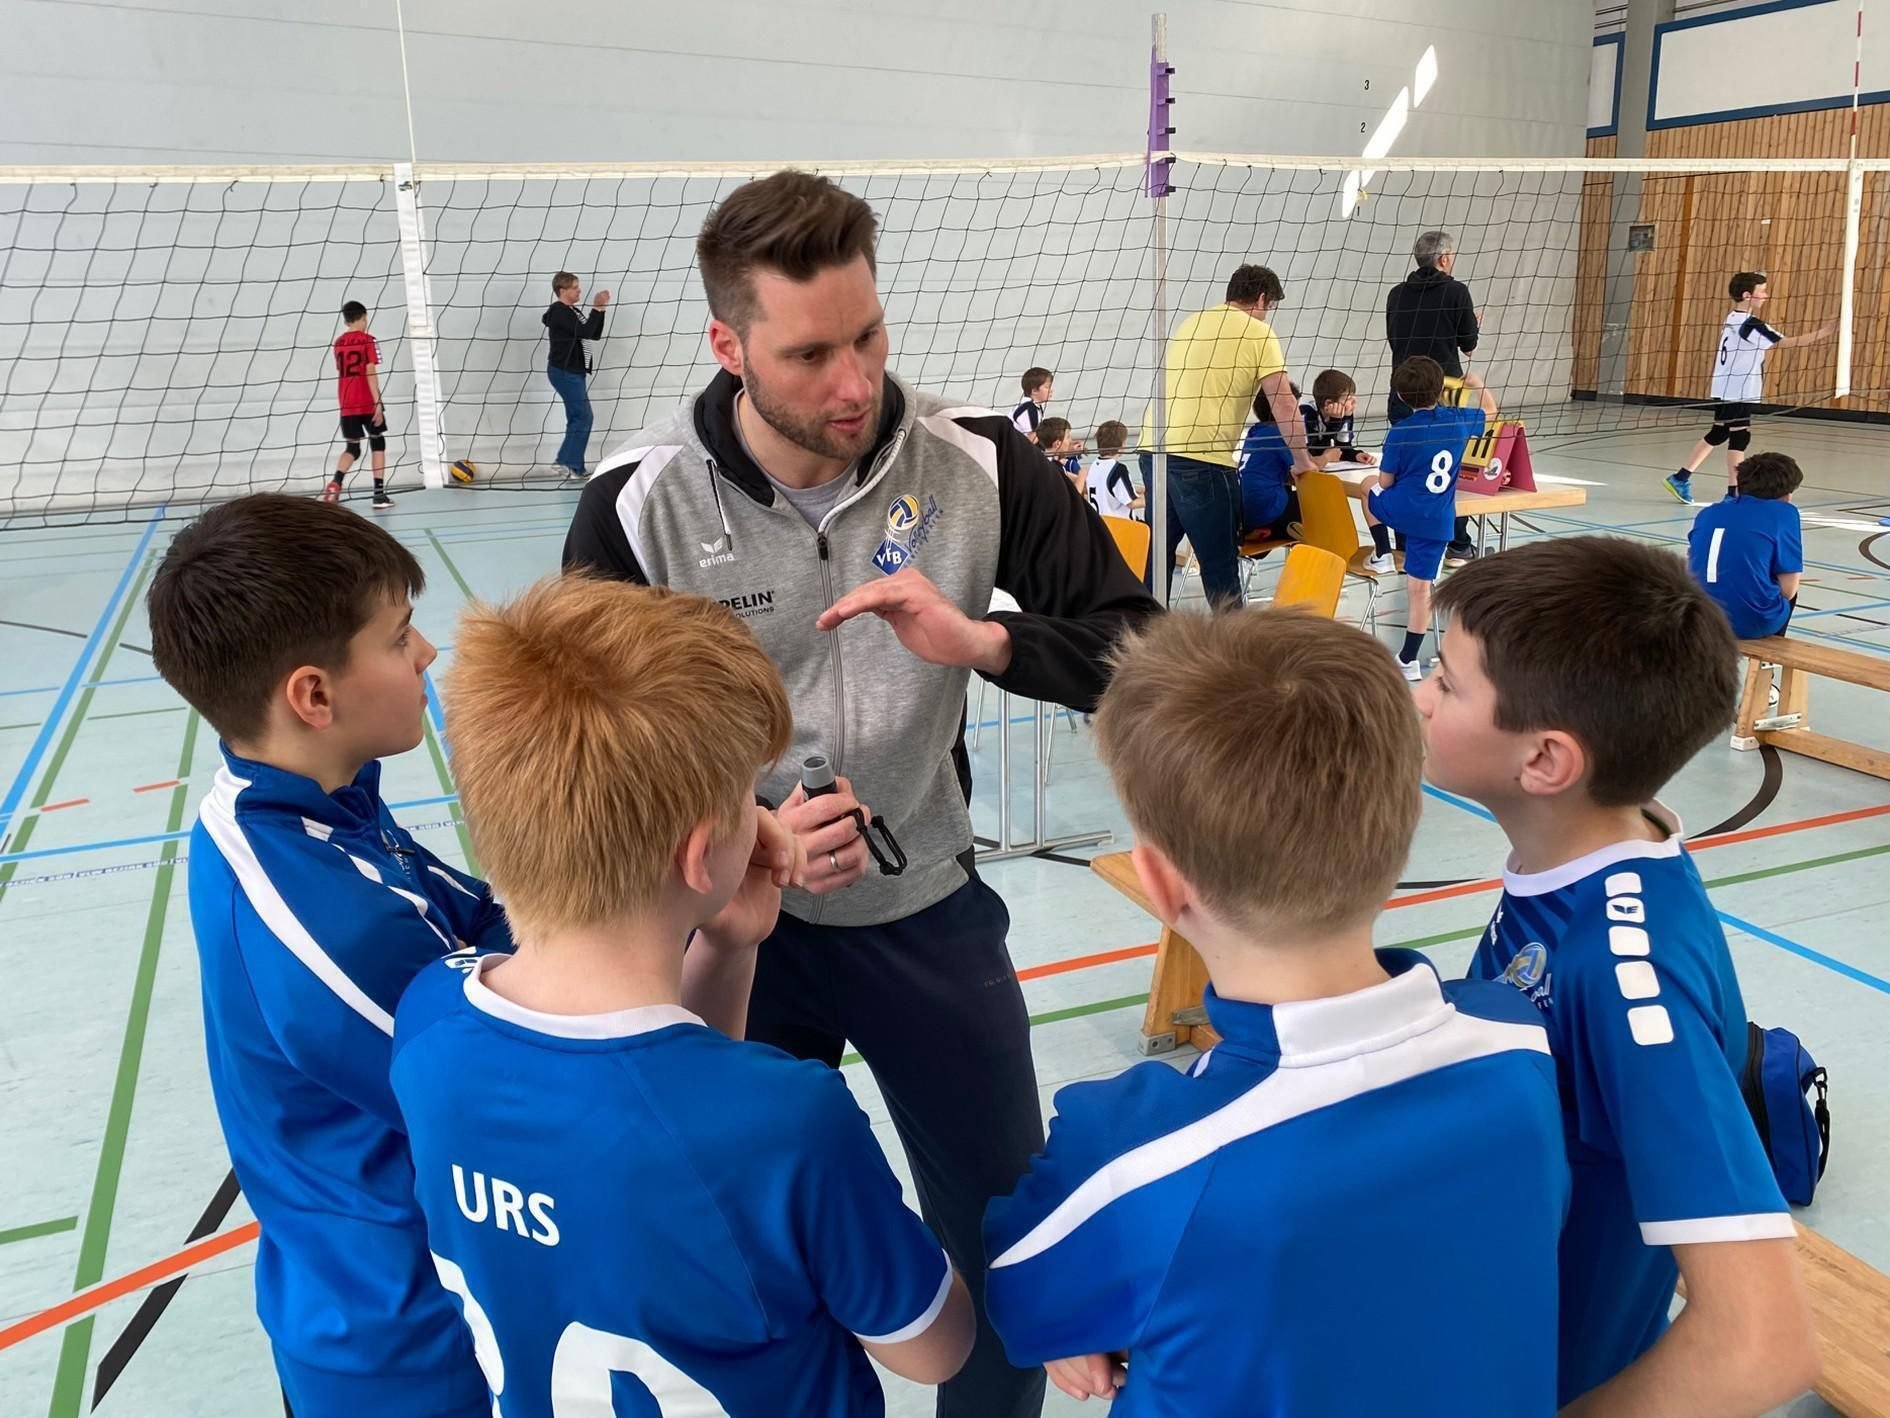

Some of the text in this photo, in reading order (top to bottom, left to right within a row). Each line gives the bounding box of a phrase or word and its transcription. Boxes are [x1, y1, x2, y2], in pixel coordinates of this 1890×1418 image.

[1364, 79, 1370, 90] 3
[1360, 121, 1367, 133] 2
[1720, 336, 1729, 366] 6
[336, 350, 363, 377] 12
[1426, 450, 1453, 493] 8
[699, 552, 735, 568] erima
[876, 546, 903, 567] VfB
[1706, 527, 1726, 584] 1
[718, 591, 773, 610] PELIN
[735, 606, 775, 619] OLUTIONS
[452, 1163, 560, 1247] URS
